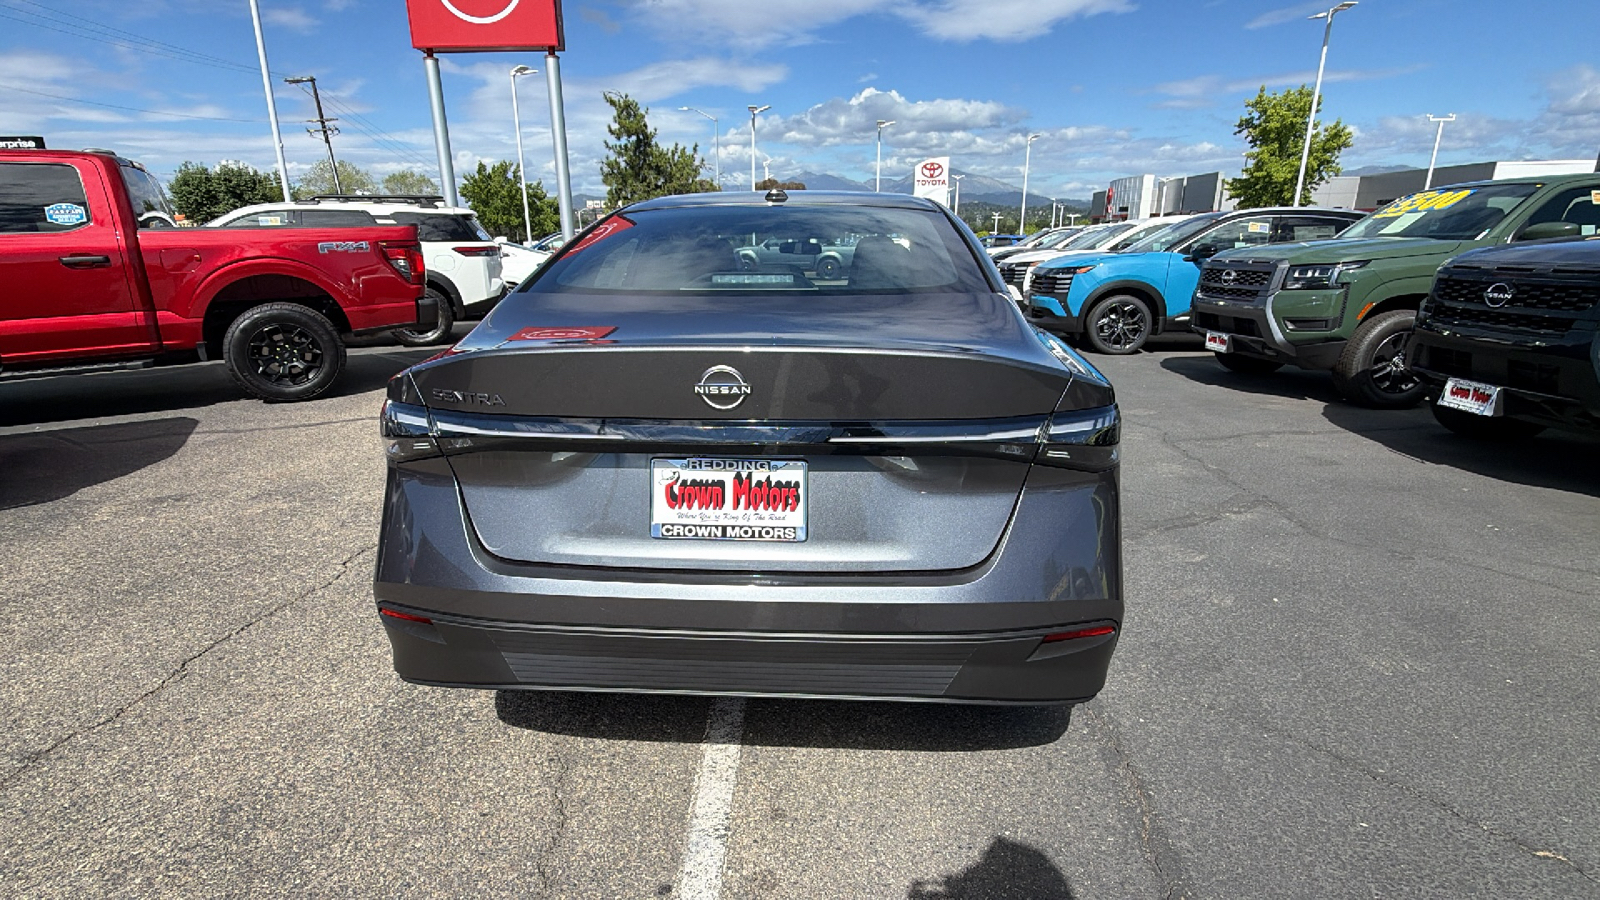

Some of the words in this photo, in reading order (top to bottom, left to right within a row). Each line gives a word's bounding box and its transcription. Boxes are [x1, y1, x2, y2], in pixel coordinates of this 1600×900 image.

[916, 179, 947, 187] TOYOTA
[318, 241, 370, 254] FX4
[694, 386, 751, 394] NISSAN
[432, 388, 507, 406] SENTRA
[688, 459, 770, 471] REDDING
[665, 472, 726, 510] Crown
[732, 472, 800, 512] Motors
[661, 525, 723, 538] CROWN
[726, 526, 797, 539] MOTORS
